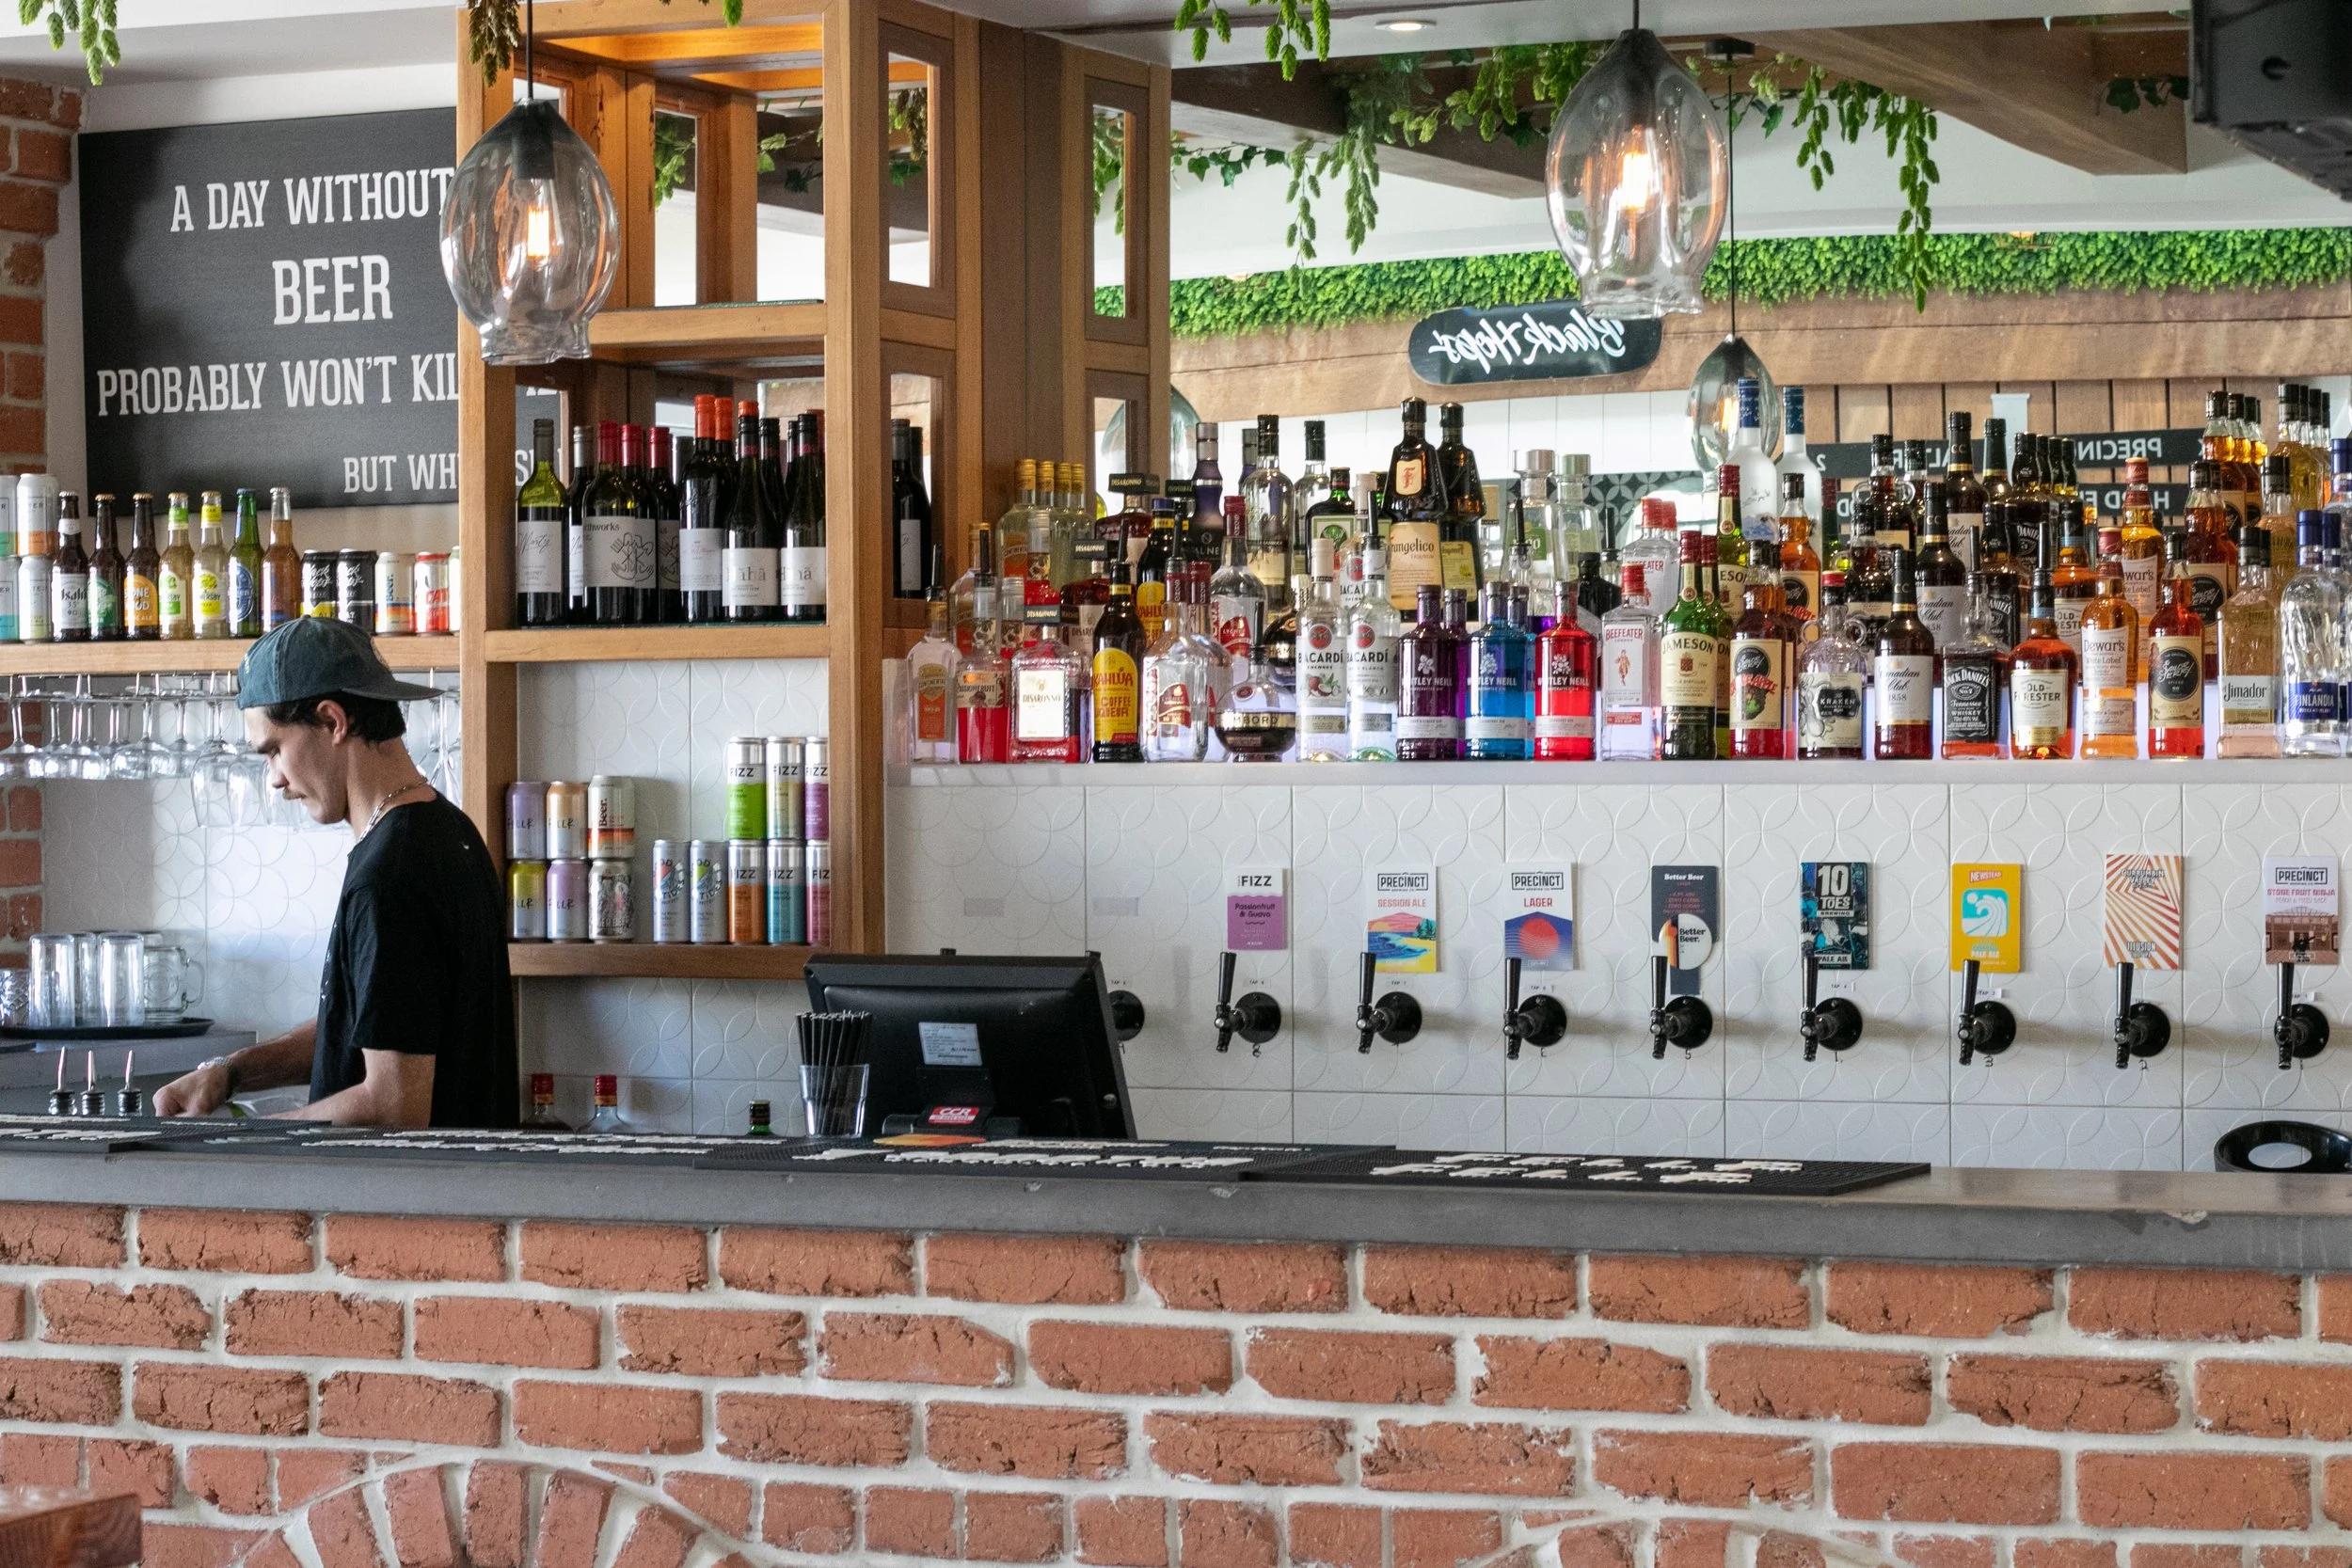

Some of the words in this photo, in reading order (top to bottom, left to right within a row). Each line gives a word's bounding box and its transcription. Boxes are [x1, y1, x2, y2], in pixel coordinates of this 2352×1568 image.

[170, 185, 194, 232] A
[207, 179, 268, 231] DAY
[283, 167, 455, 226] WITHOUT
[272, 254, 393, 325] BEER
[97, 361, 266, 417] PROBABLY
[280, 355, 398, 410] WON'T
[411, 352, 458, 402] KIL
[343, 453, 398, 494] BUT
[407, 451, 459, 491] WH
[1605, 627, 1644, 641] BEEFEATER
[1662, 637, 1714, 656] JAMESON
[2084, 639, 2124, 652] Dewar's
[1023, 694, 1061, 704] DISARONNO
[2014, 692, 2060, 701] FRESTER
[599, 798, 608, 827] Beer.
[812, 869, 830, 879] FIZ
[1818, 864, 1850, 896] 10
[2279, 871, 2325, 881] PRECINCT
[1241, 876, 1272, 886] FIZZ
[1380, 877, 1425, 888] PRECINCT
[1515, 876, 1561, 887] PRECINCT
[1377, 898, 1411, 908] SESSION
[1412, 898, 1427, 908] ALE
[1523, 897, 1553, 908] LAGER
